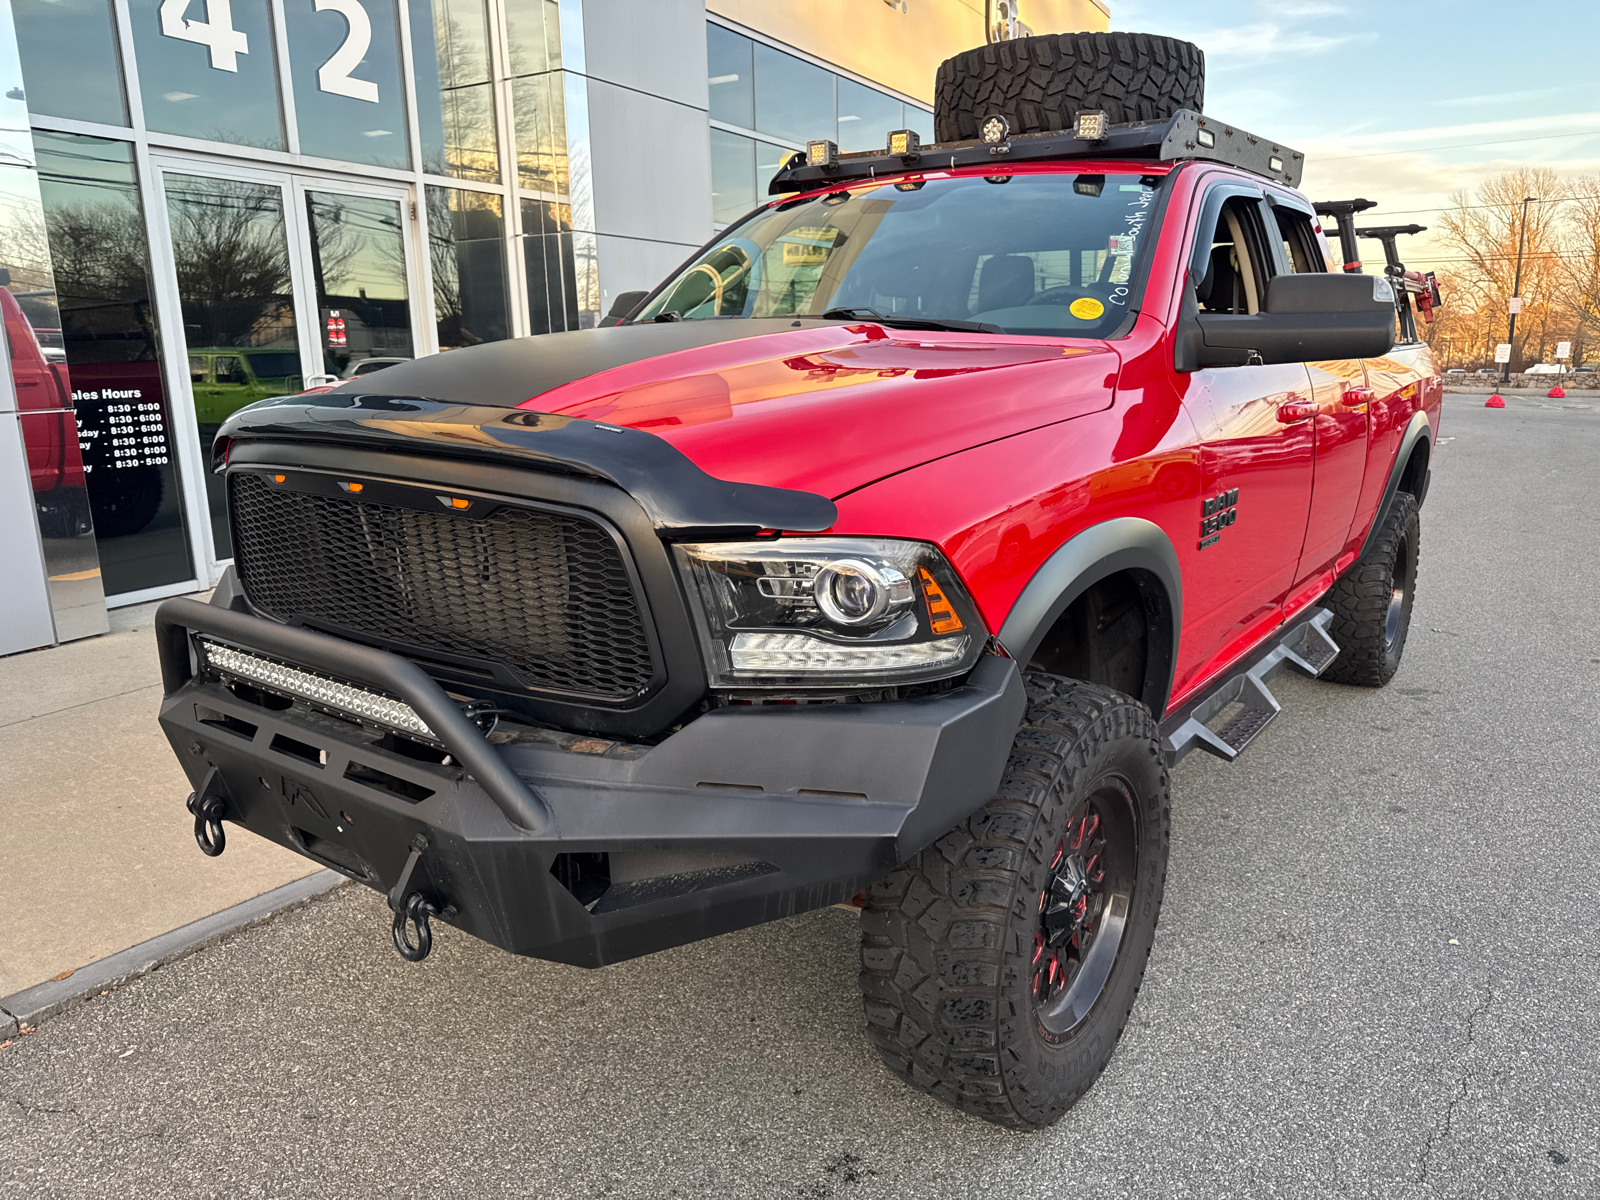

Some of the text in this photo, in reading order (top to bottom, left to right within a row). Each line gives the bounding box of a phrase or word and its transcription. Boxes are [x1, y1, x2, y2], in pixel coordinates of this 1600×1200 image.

[71, 388, 142, 400] ales Hours
[1202, 487, 1239, 518] RAM
[1200, 507, 1237, 538] 1500
